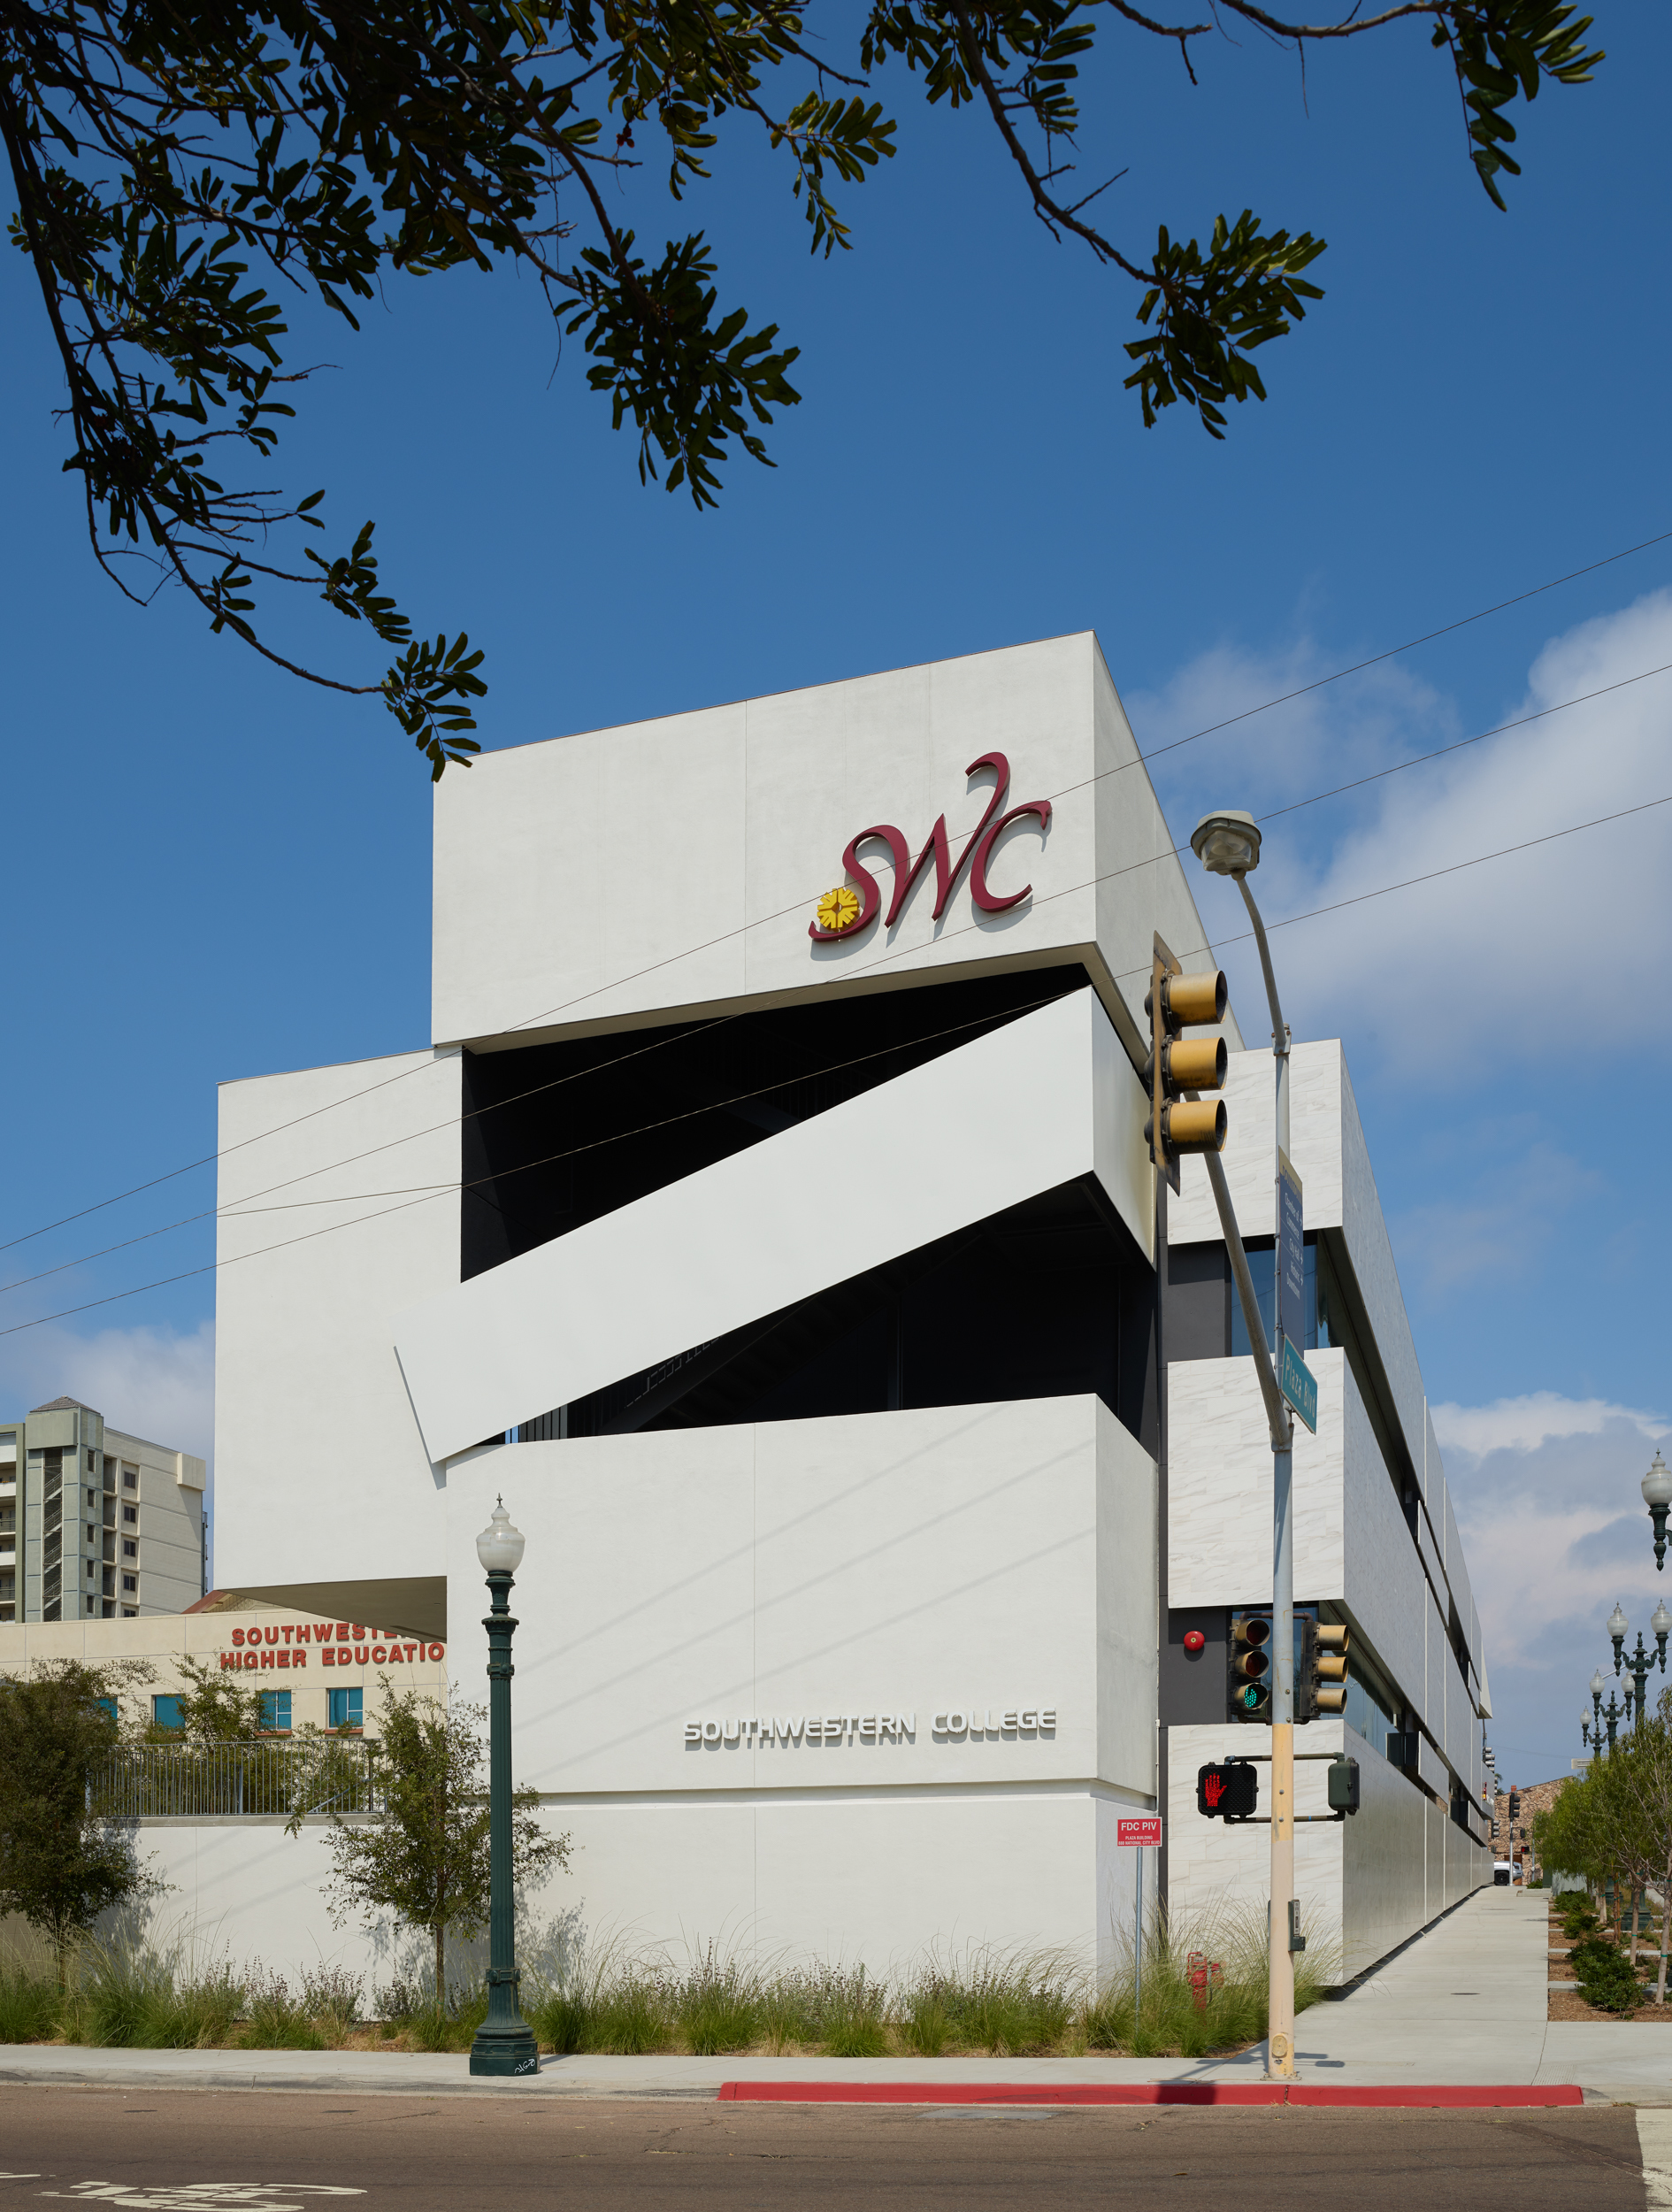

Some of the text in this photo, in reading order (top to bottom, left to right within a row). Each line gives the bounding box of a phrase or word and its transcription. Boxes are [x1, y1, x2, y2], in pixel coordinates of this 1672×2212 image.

[808, 751, 1053, 942] SWC
[1285, 1354, 1315, 1418] Plaza Blvd
[220, 1642, 445, 1670] HIGHER EDUCATIO
[683, 1707, 1056, 1741] SOUTHWESTERN COLLEGE
[1122, 1822, 1139, 1831] FDC
